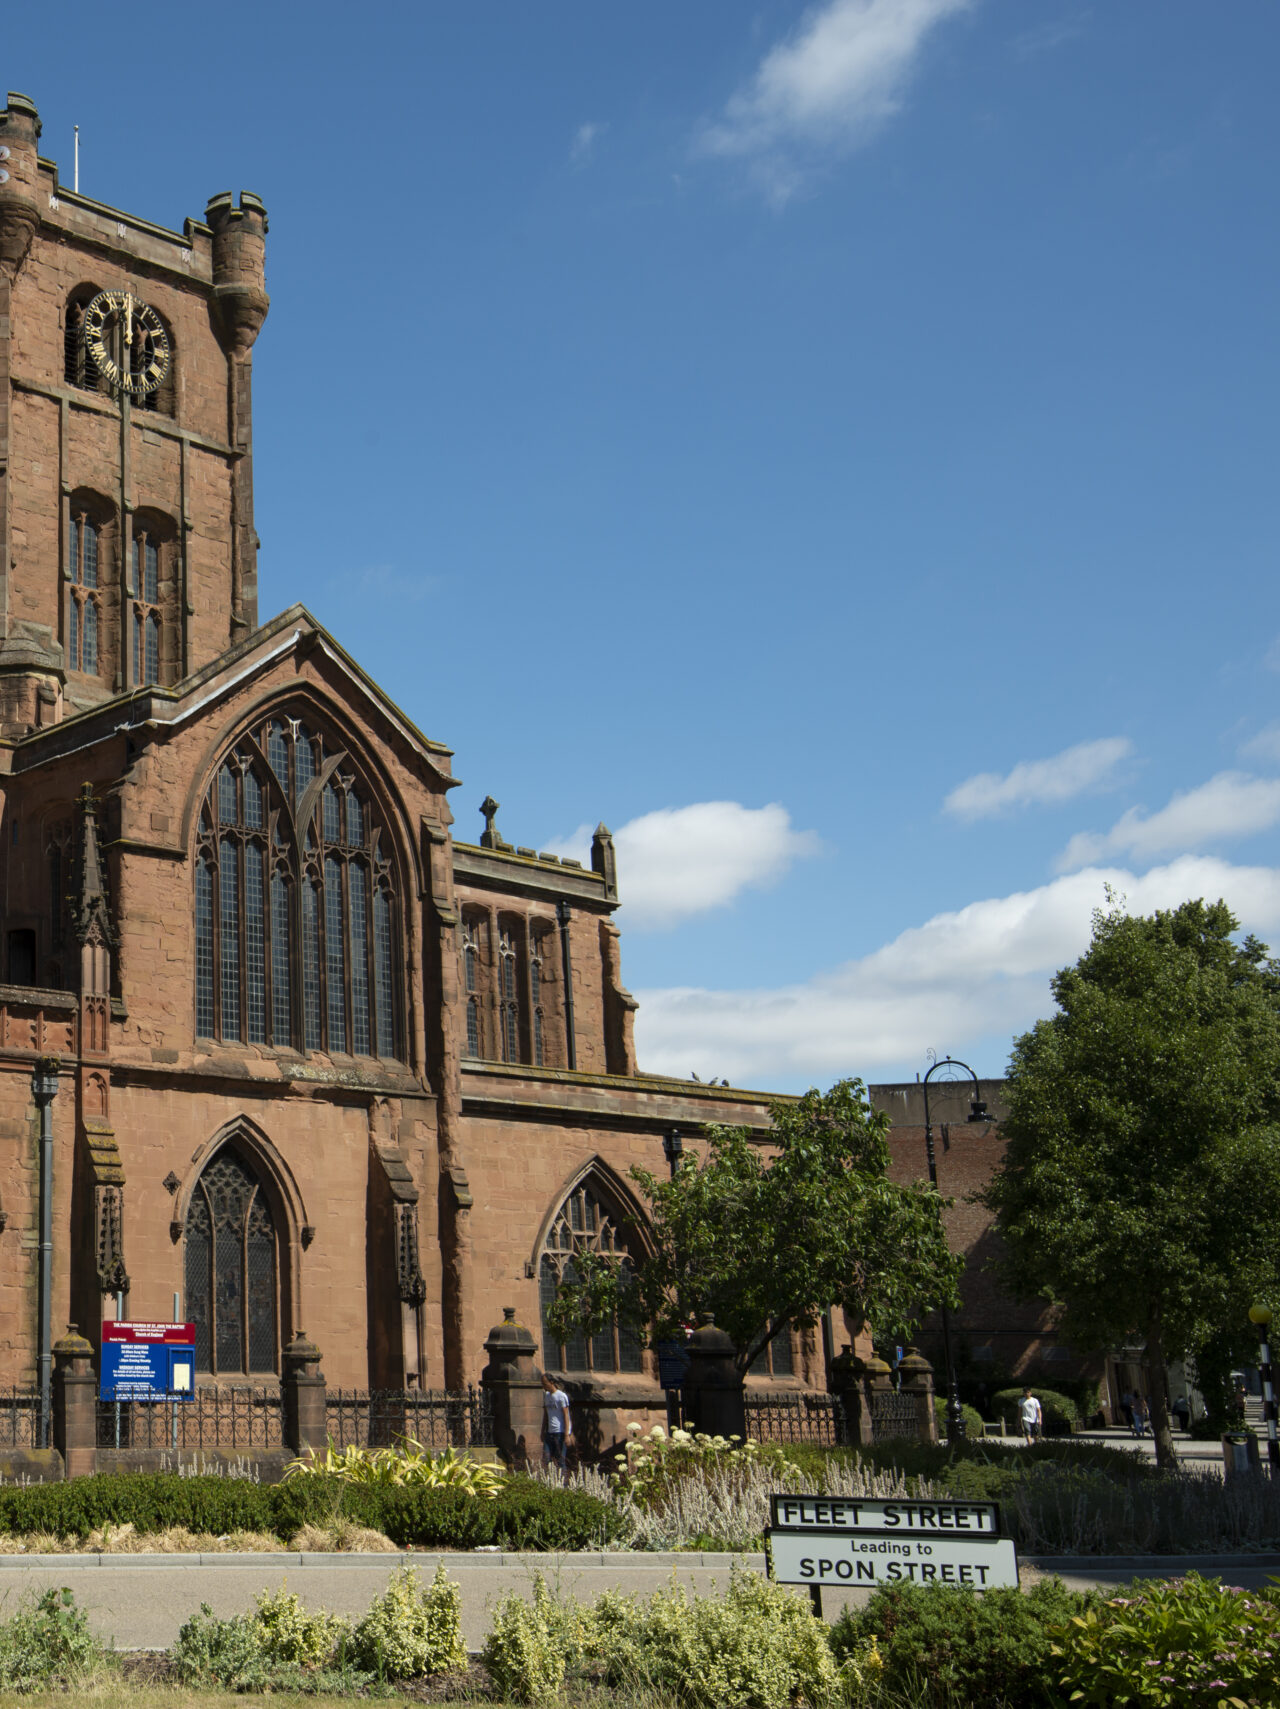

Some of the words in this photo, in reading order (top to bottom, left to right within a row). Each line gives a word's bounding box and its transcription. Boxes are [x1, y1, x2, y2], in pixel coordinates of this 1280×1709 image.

[95, 307, 105, 320] X
[90, 324, 102, 337] IX
[154, 348, 164, 358] III
[105, 360, 117, 379] VII
[123, 372, 133, 388] VI
[141, 374, 149, 386] V
[784, 1502, 863, 1525] FLEET
[883, 1505, 989, 1529] STREET
[851, 1540, 911, 1557] Leading
[916, 1542, 933, 1556] to
[799, 1558, 875, 1580] SPON
[886, 1561, 990, 1585] STREET
